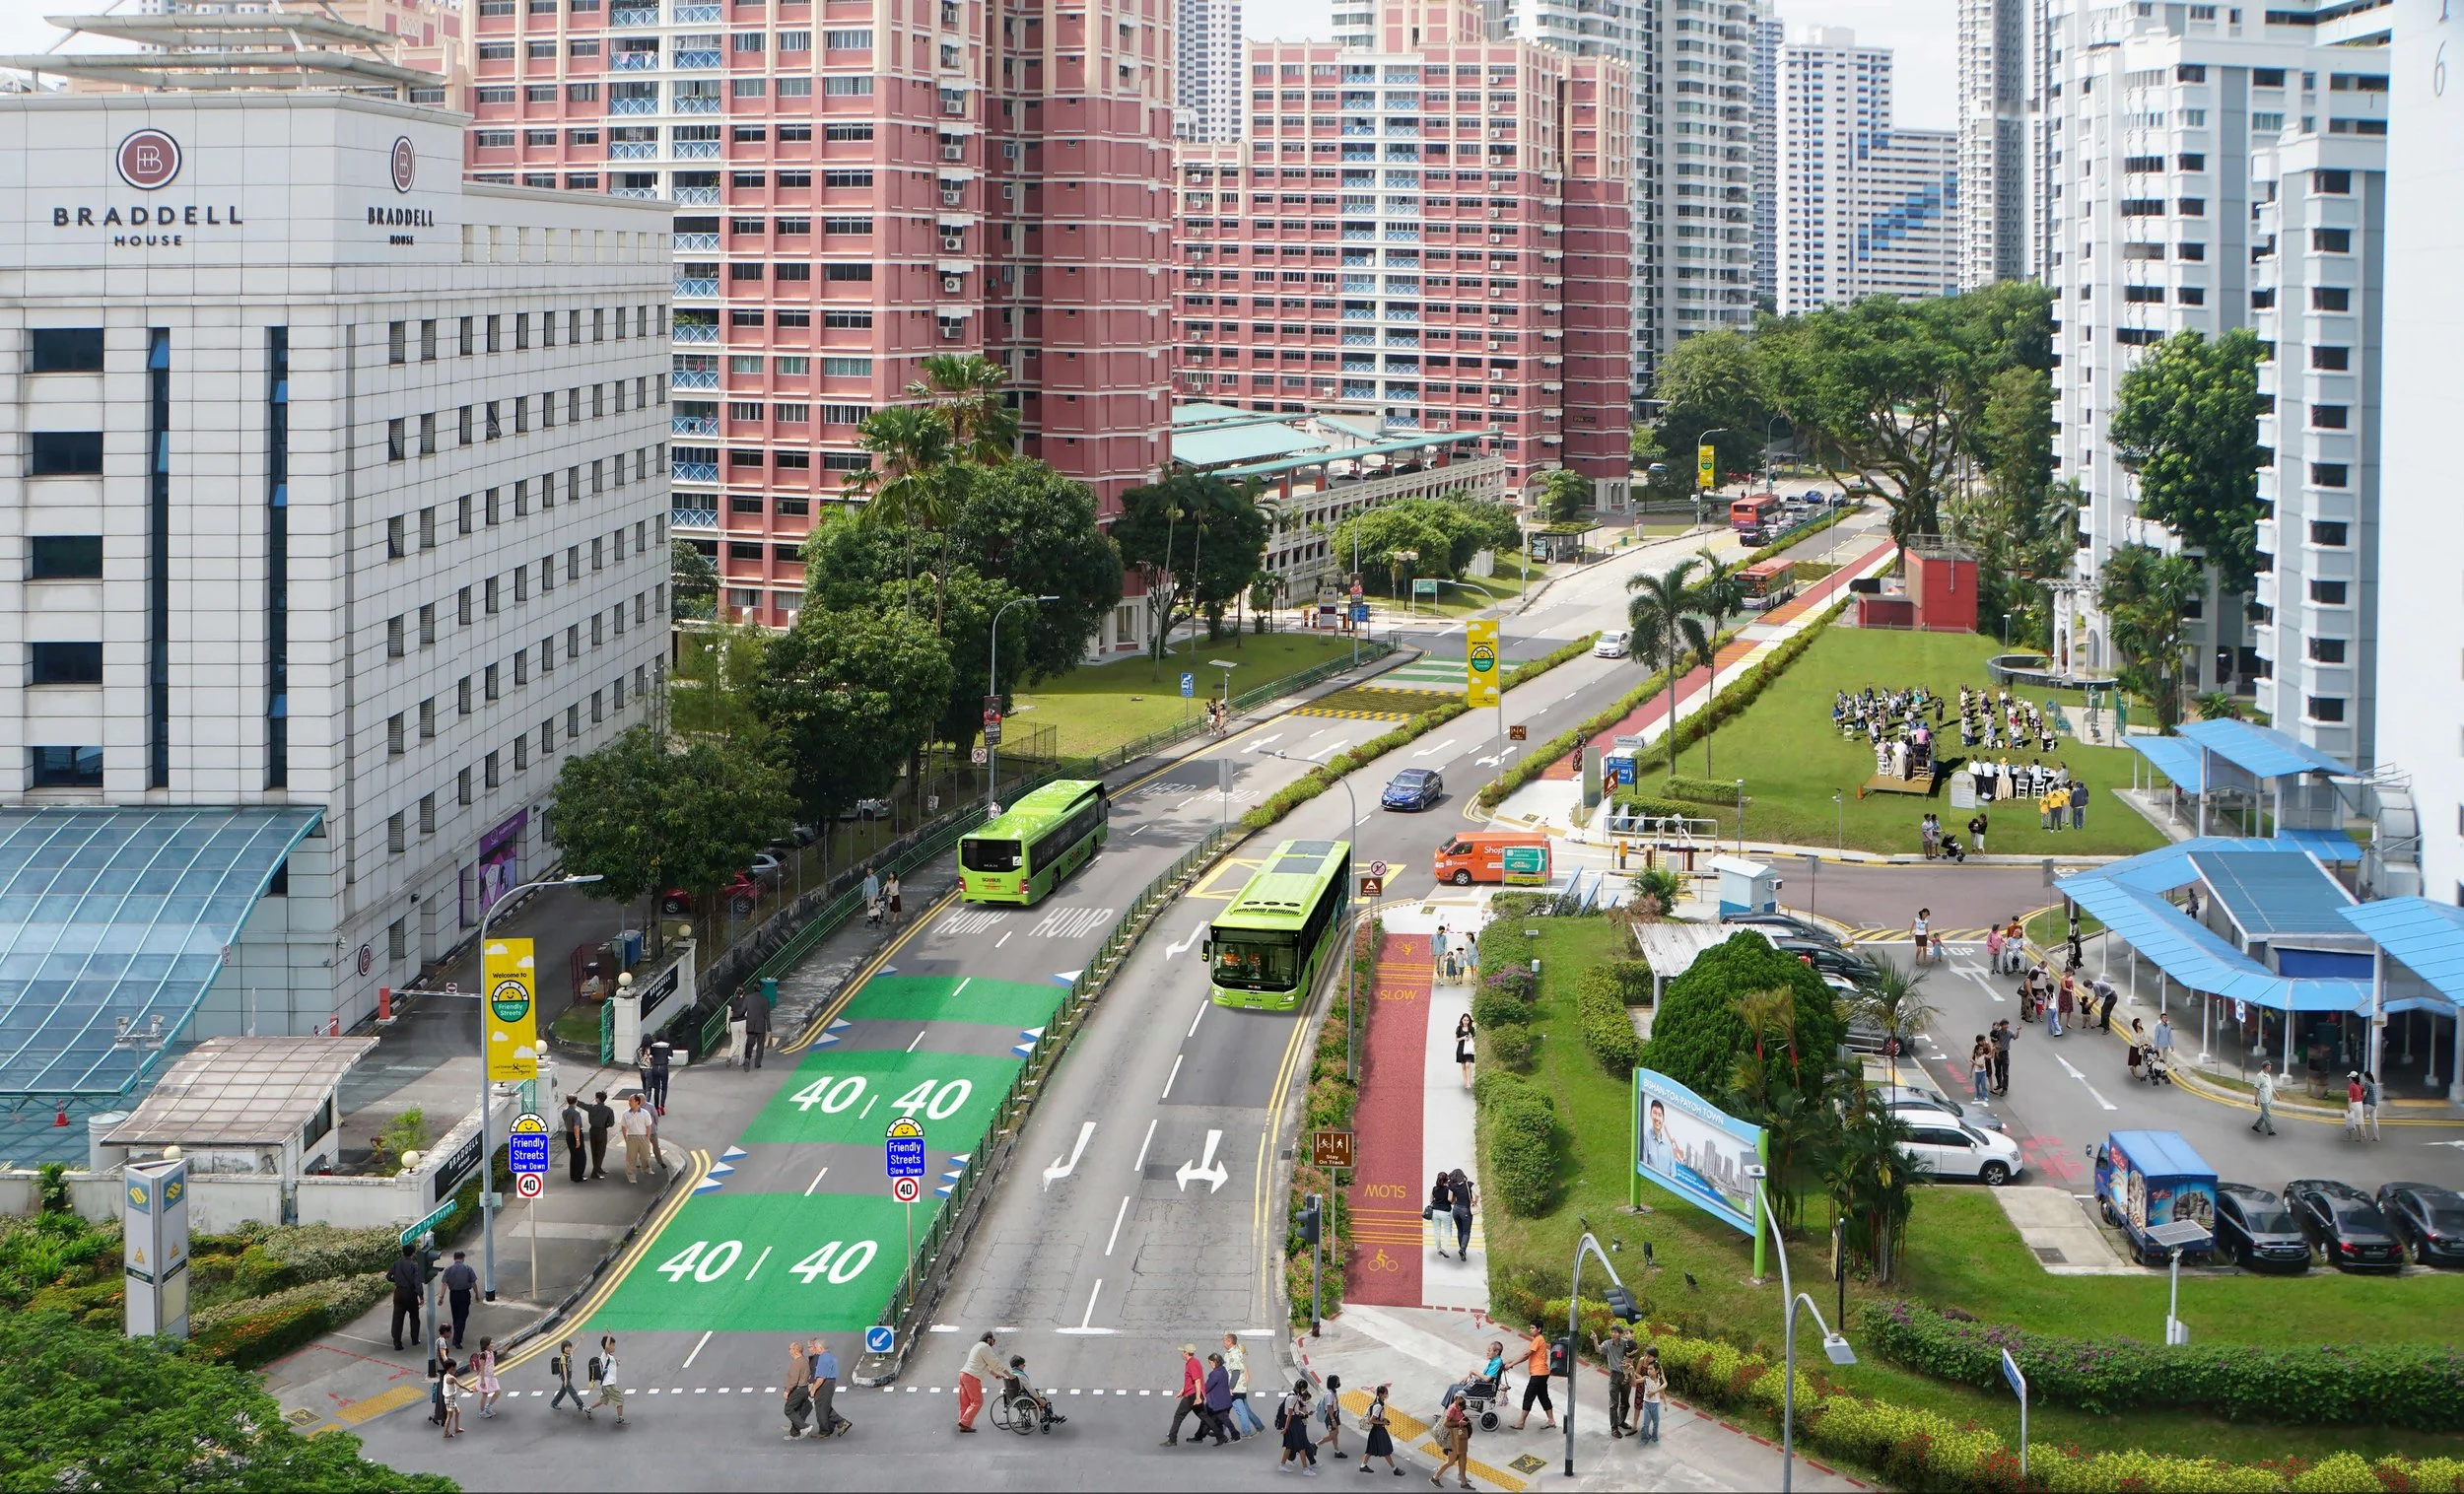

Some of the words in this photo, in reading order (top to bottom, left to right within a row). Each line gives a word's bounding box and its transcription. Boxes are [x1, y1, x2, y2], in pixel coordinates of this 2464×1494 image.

[53, 205, 243, 227] BRADDELL
[368, 206, 435, 228] BRADDELL
[114, 235, 182, 246] HOUSE
[389, 235, 415, 245] HOUSE
[1131, 782, 1197, 796] AHEAD
[932, 908, 1010, 934] HUMP
[1028, 907, 1115, 938] HUMP
[1379, 989, 1417, 1000] SLOW
[788, 1075, 867, 1114] 40
[890, 1078, 973, 1120] 40
[1679, 1096, 1702, 1115] PAYOH
[1702, 1107, 1724, 1125] TOWN
[513, 1137, 545, 1150] Friendly
[889, 1142, 922, 1154] Friendly
[448, 1136, 479, 1170] BRADDELL
[513, 1149, 544, 1160] Streets
[890, 1155, 922, 1164] Streets
[523, 1180, 536, 1191] 40
[900, 1184, 913, 1195] 40
[1364, 1184, 1407, 1199] SLOW
[423, 1217, 435, 1229] Toa
[435, 1203, 455, 1221] Payoh
[655, 1240, 744, 1283] 40
[788, 1240, 879, 1284] 40
